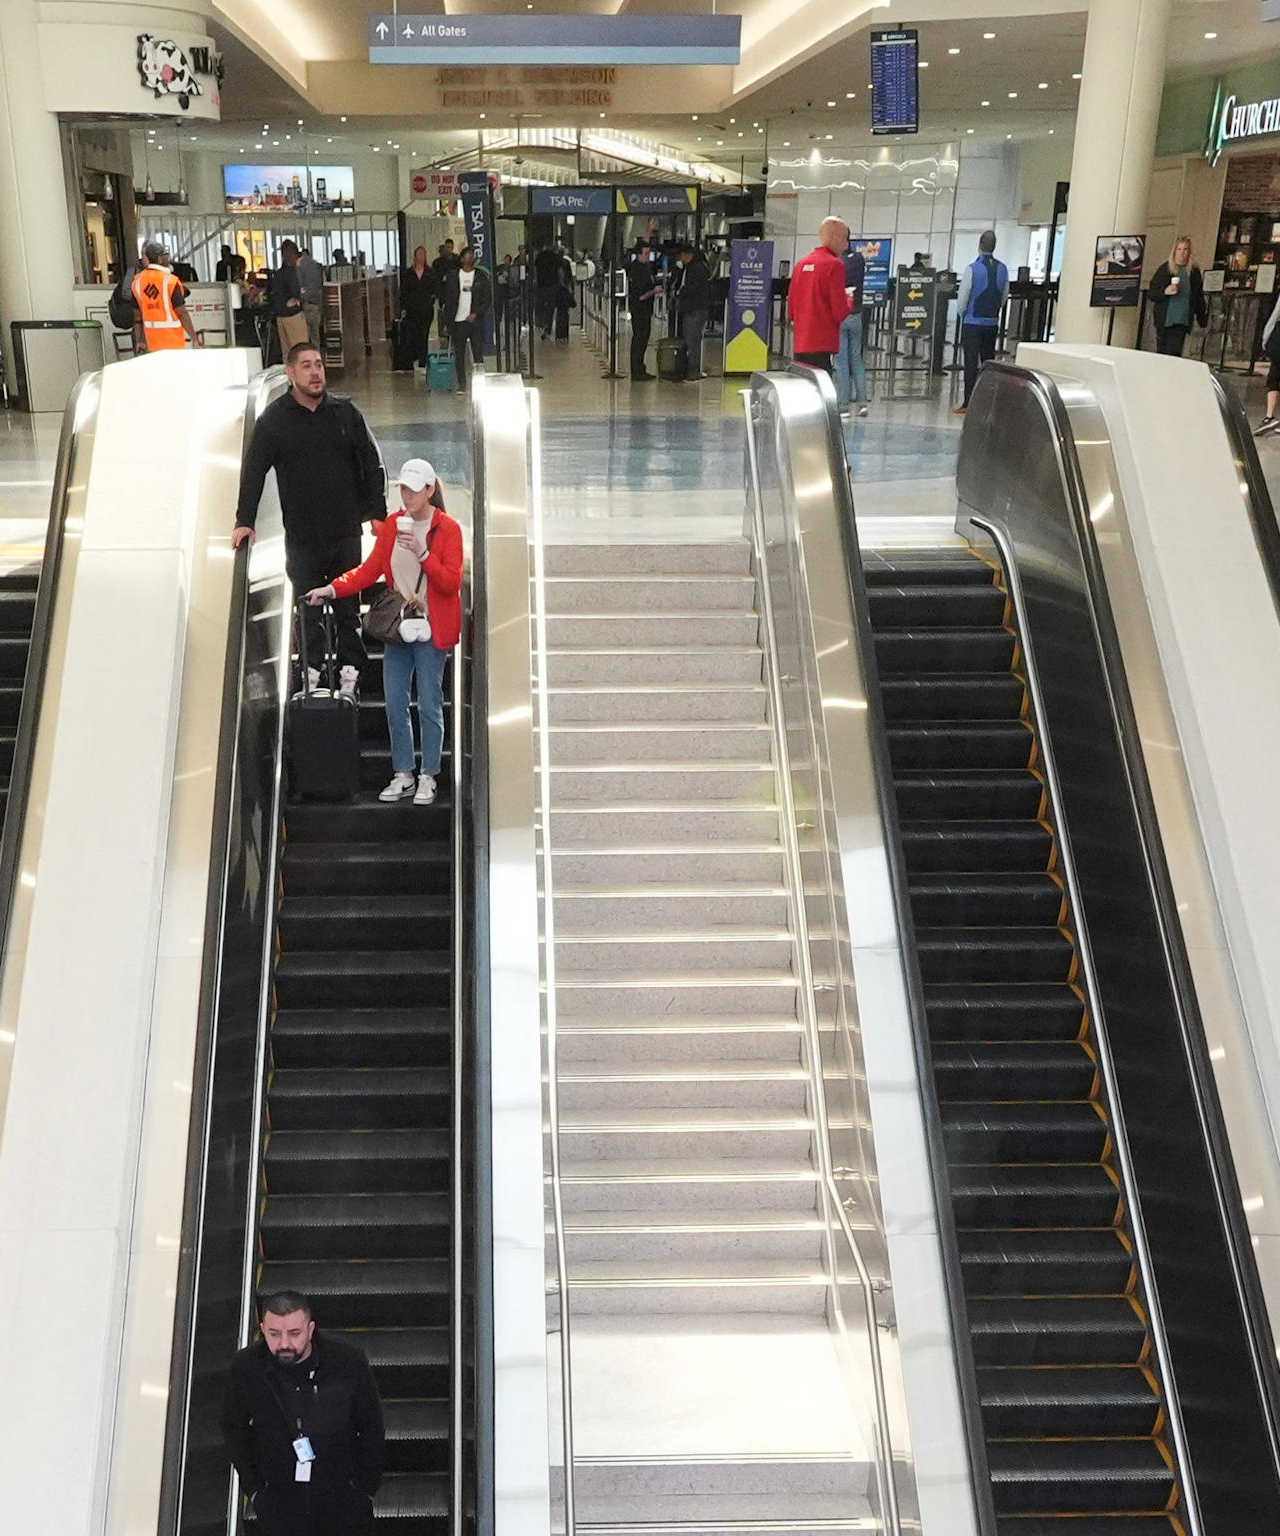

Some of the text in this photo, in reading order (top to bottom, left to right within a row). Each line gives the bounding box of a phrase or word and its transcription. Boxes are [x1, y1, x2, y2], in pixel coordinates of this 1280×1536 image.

[421, 24, 467, 37] All Gates
[550, 196, 567, 207] TSA
[643, 196, 668, 204] CLEAR
[471, 200, 484, 231] TSA
[472, 233, 484, 258] Pre
